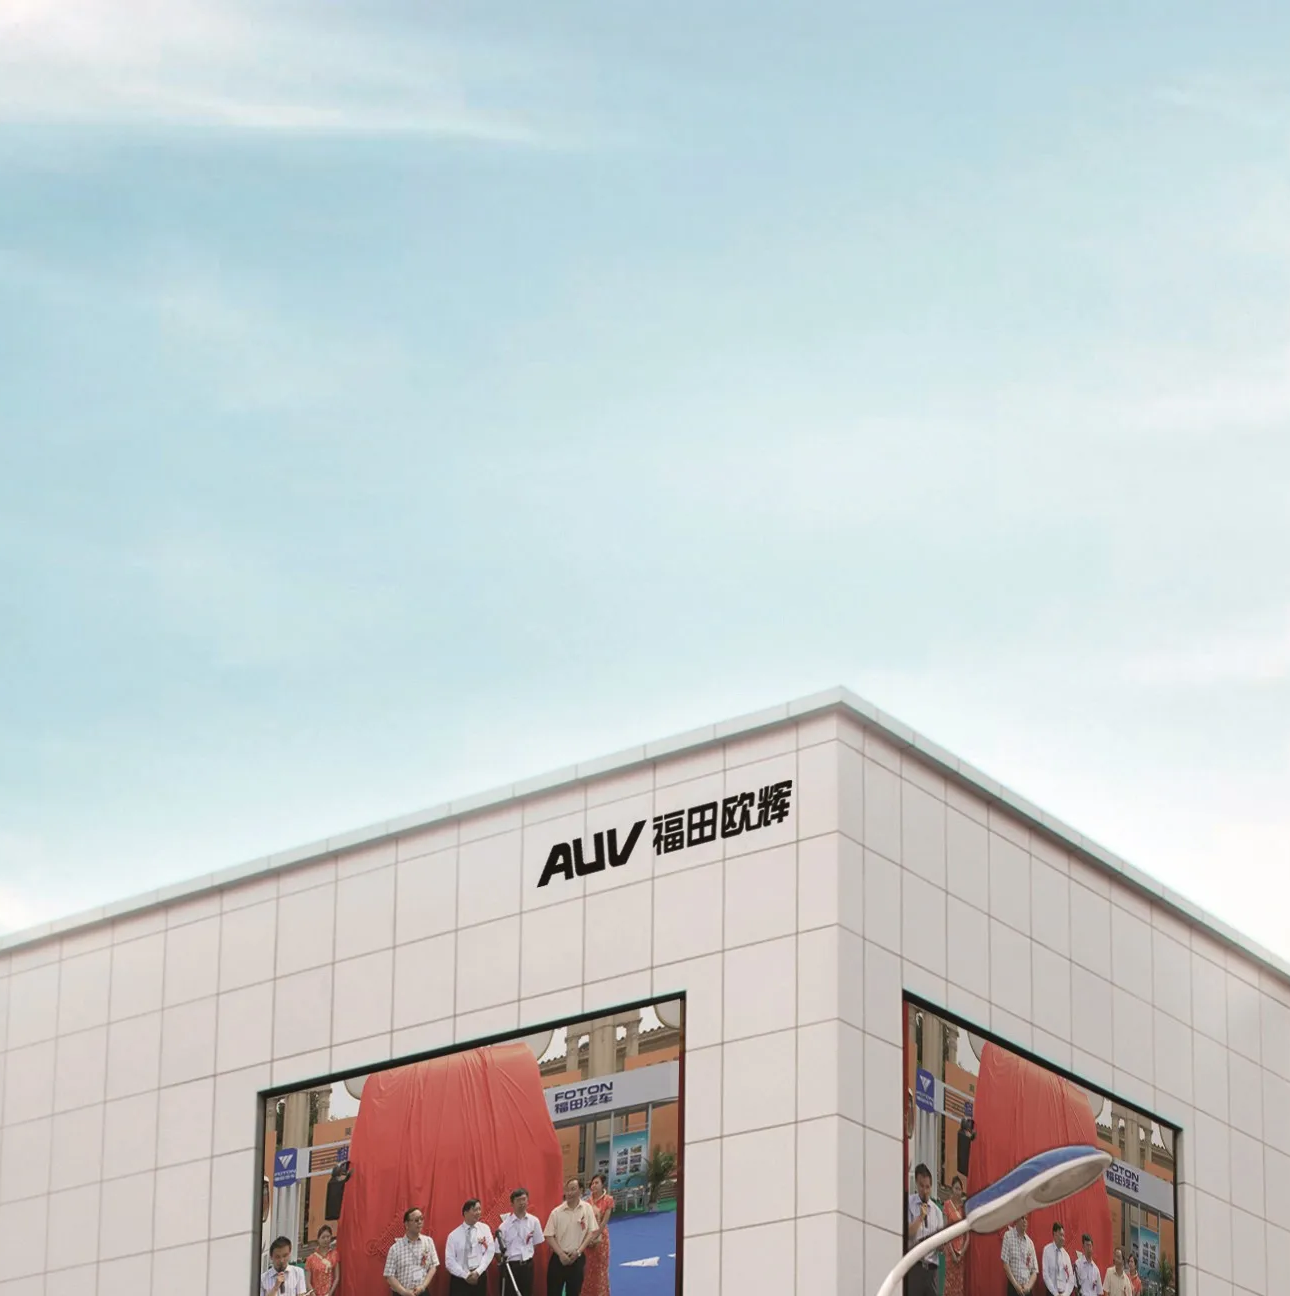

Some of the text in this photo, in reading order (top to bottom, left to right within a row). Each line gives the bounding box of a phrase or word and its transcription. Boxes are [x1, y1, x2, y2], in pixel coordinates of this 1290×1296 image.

[537, 780, 793, 888] AUV 福田欧辉
[554, 1081, 614, 1102] FOTON
[554, 1092, 614, 1115] 福田汽车
[1110, 1162, 1139, 1183] OTON
